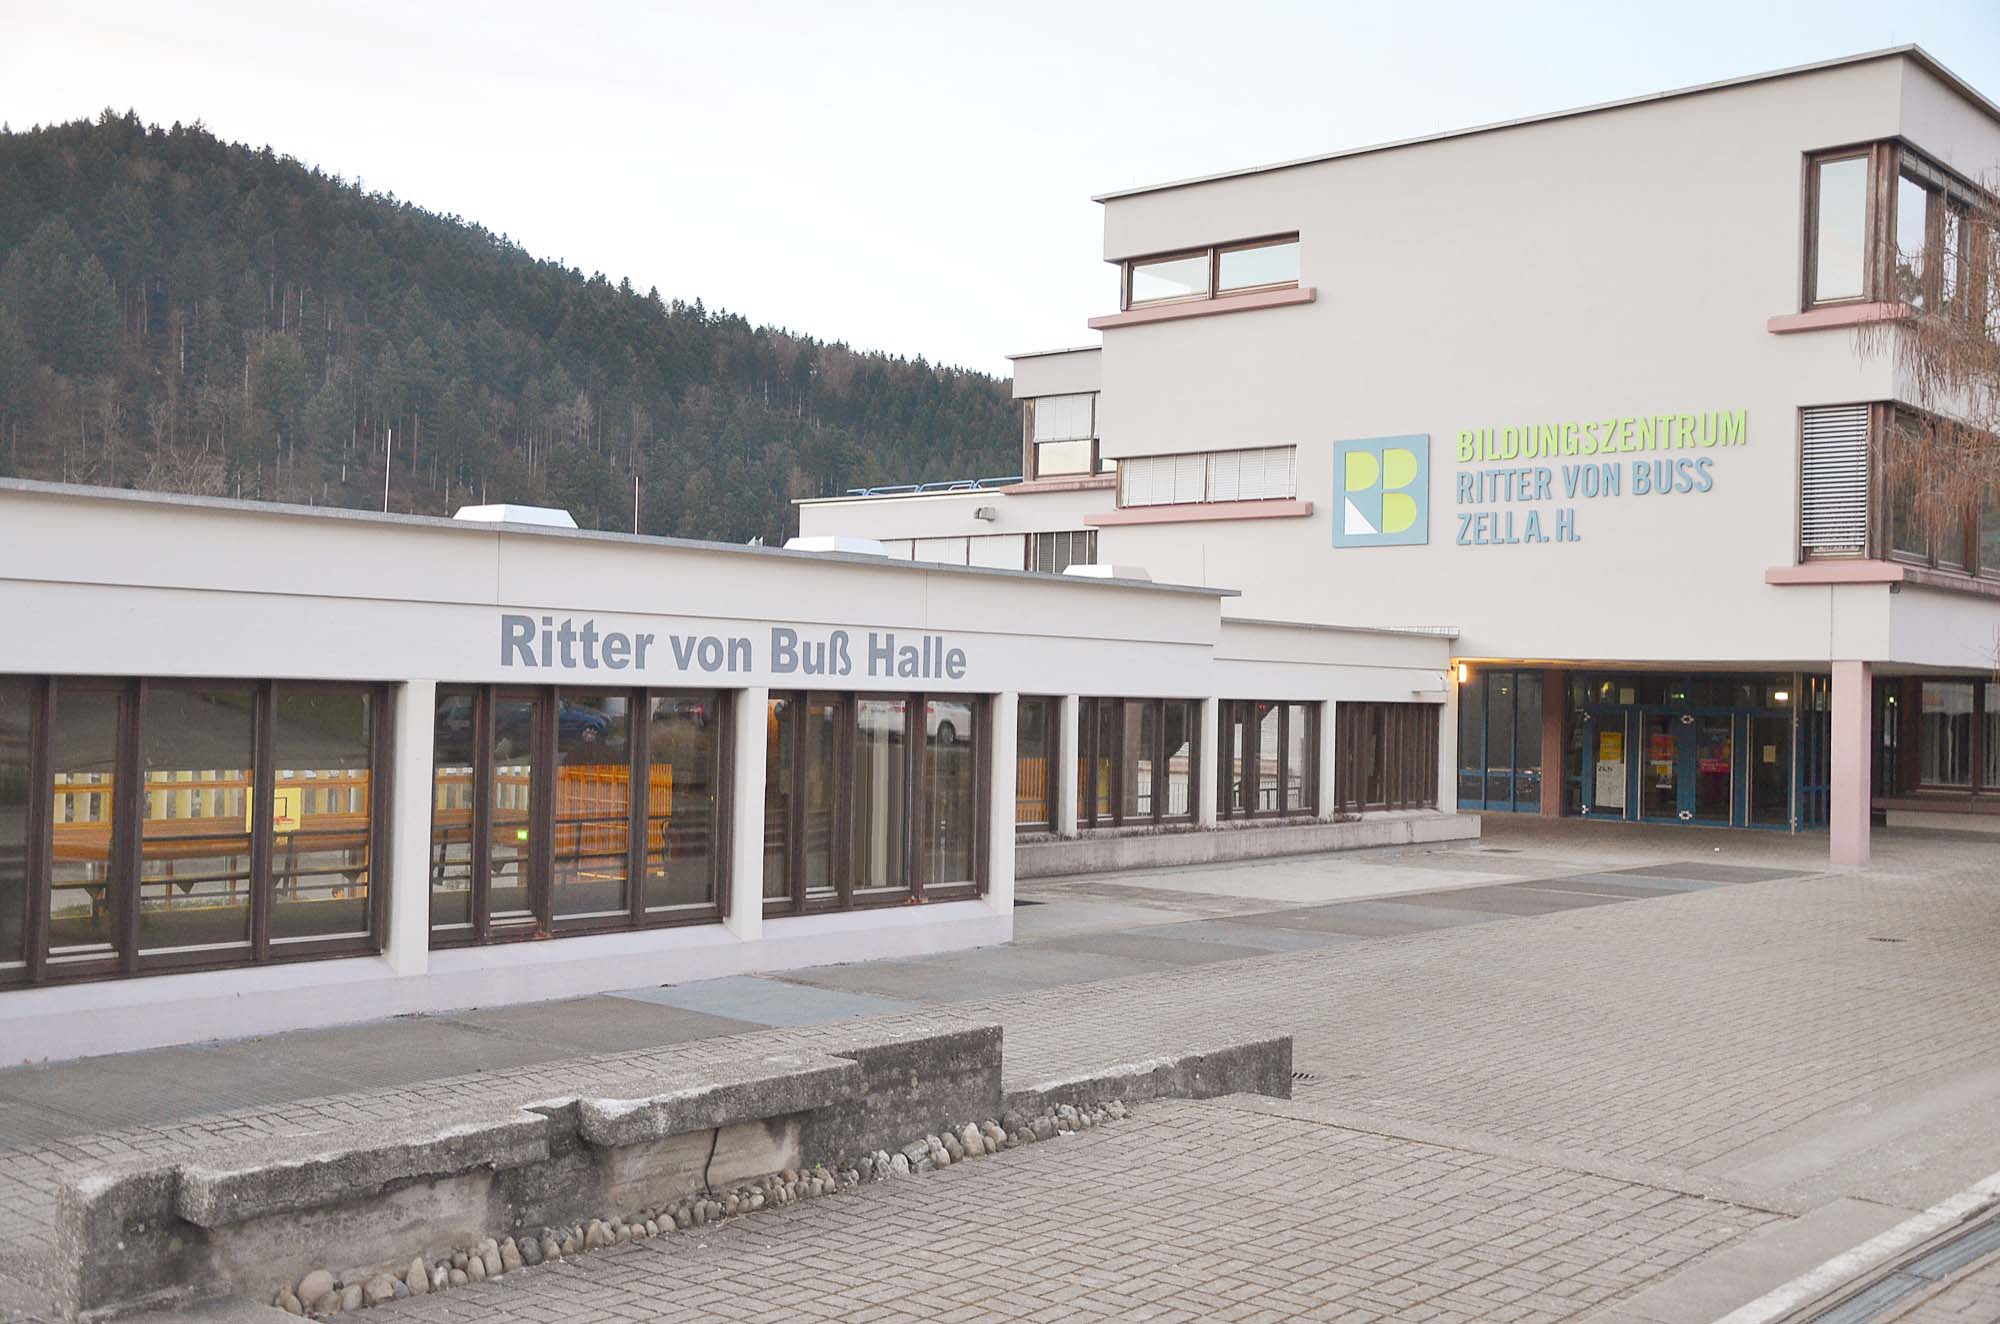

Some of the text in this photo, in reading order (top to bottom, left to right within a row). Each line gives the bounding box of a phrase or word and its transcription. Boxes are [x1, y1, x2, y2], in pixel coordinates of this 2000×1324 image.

[1457, 409, 1747, 463] BILDUNGSZENTRUM
[1456, 457, 1713, 504] RITTER VON BUSS
[1456, 511, 1520, 545] ZELL
[500, 613, 968, 680] Ritter von Buß Halle
